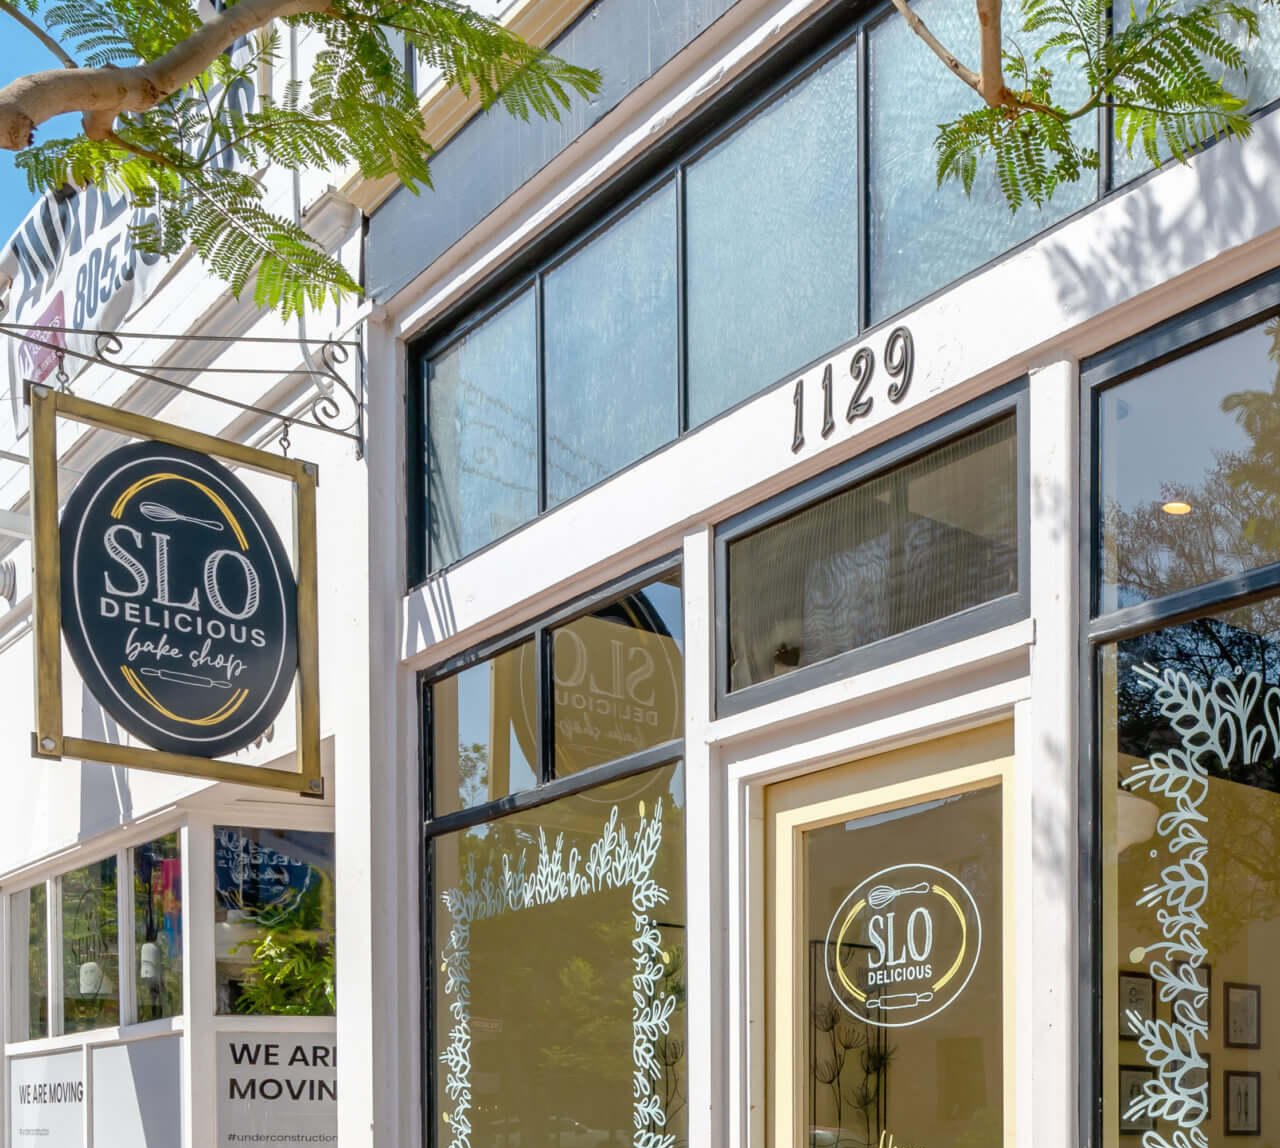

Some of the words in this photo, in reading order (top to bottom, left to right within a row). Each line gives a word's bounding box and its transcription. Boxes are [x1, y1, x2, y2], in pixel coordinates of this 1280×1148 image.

[791, 325, 915, 455] 1129
[103, 524, 261, 621] SLO
[100, 597, 267, 647] DELICIOUS
[125, 627, 183, 661] bake
[189, 638, 248, 680] shop
[867, 906, 933, 969] SLO
[867, 964, 933, 986] DELICIOUS
[229, 1043, 280, 1066] WE
[19, 1084, 31, 1104] WE
[33, 1083, 47, 1104] ARE
[49, 1081, 84, 1104] MOVING
[229, 1078, 337, 1101] MOVIN
